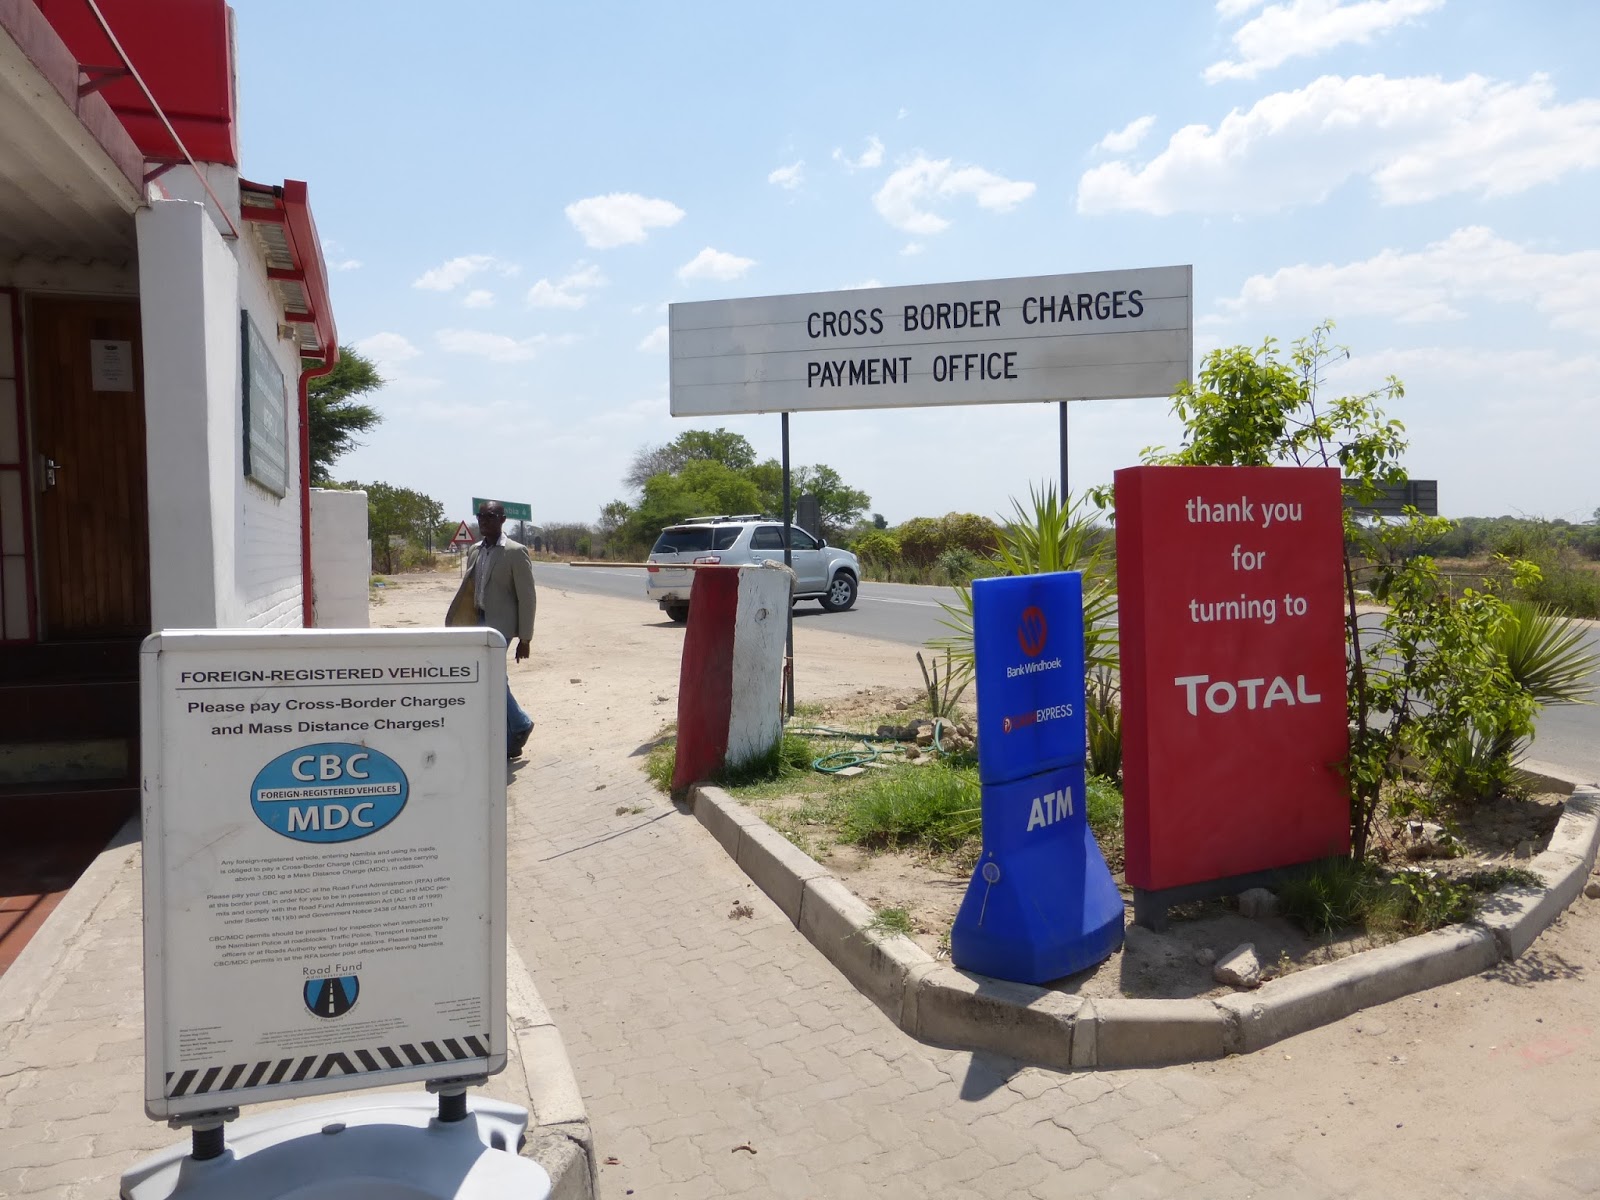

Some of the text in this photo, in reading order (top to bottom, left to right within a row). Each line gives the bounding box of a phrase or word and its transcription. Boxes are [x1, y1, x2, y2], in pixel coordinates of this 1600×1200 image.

[807, 289, 1144, 339] CROSS BORDER CHARGES
[807, 352, 1018, 388] PAYMENT OFFICE
[1185, 496, 1302, 528] thank you
[1231, 544, 1266, 570] for
[1188, 593, 1308, 624] turning to
[181, 666, 471, 684] FOREIGN-REGISTERED VEHICLES
[1006, 657, 1062, 678] Bank Windhoek
[188, 696, 466, 714] Please pay Cross-Border Charges
[1174, 674, 1322, 716] TOTAL
[211, 717, 445, 735] and Mass Distance Charges!
[291, 753, 370, 782] CBC
[260, 785, 397, 799] FOREIGN-REGISTERED VEHICLES
[288, 802, 374, 832] MDC
[1026, 786, 1074, 832] ATM
[302, 961, 363, 976] Road Fund
